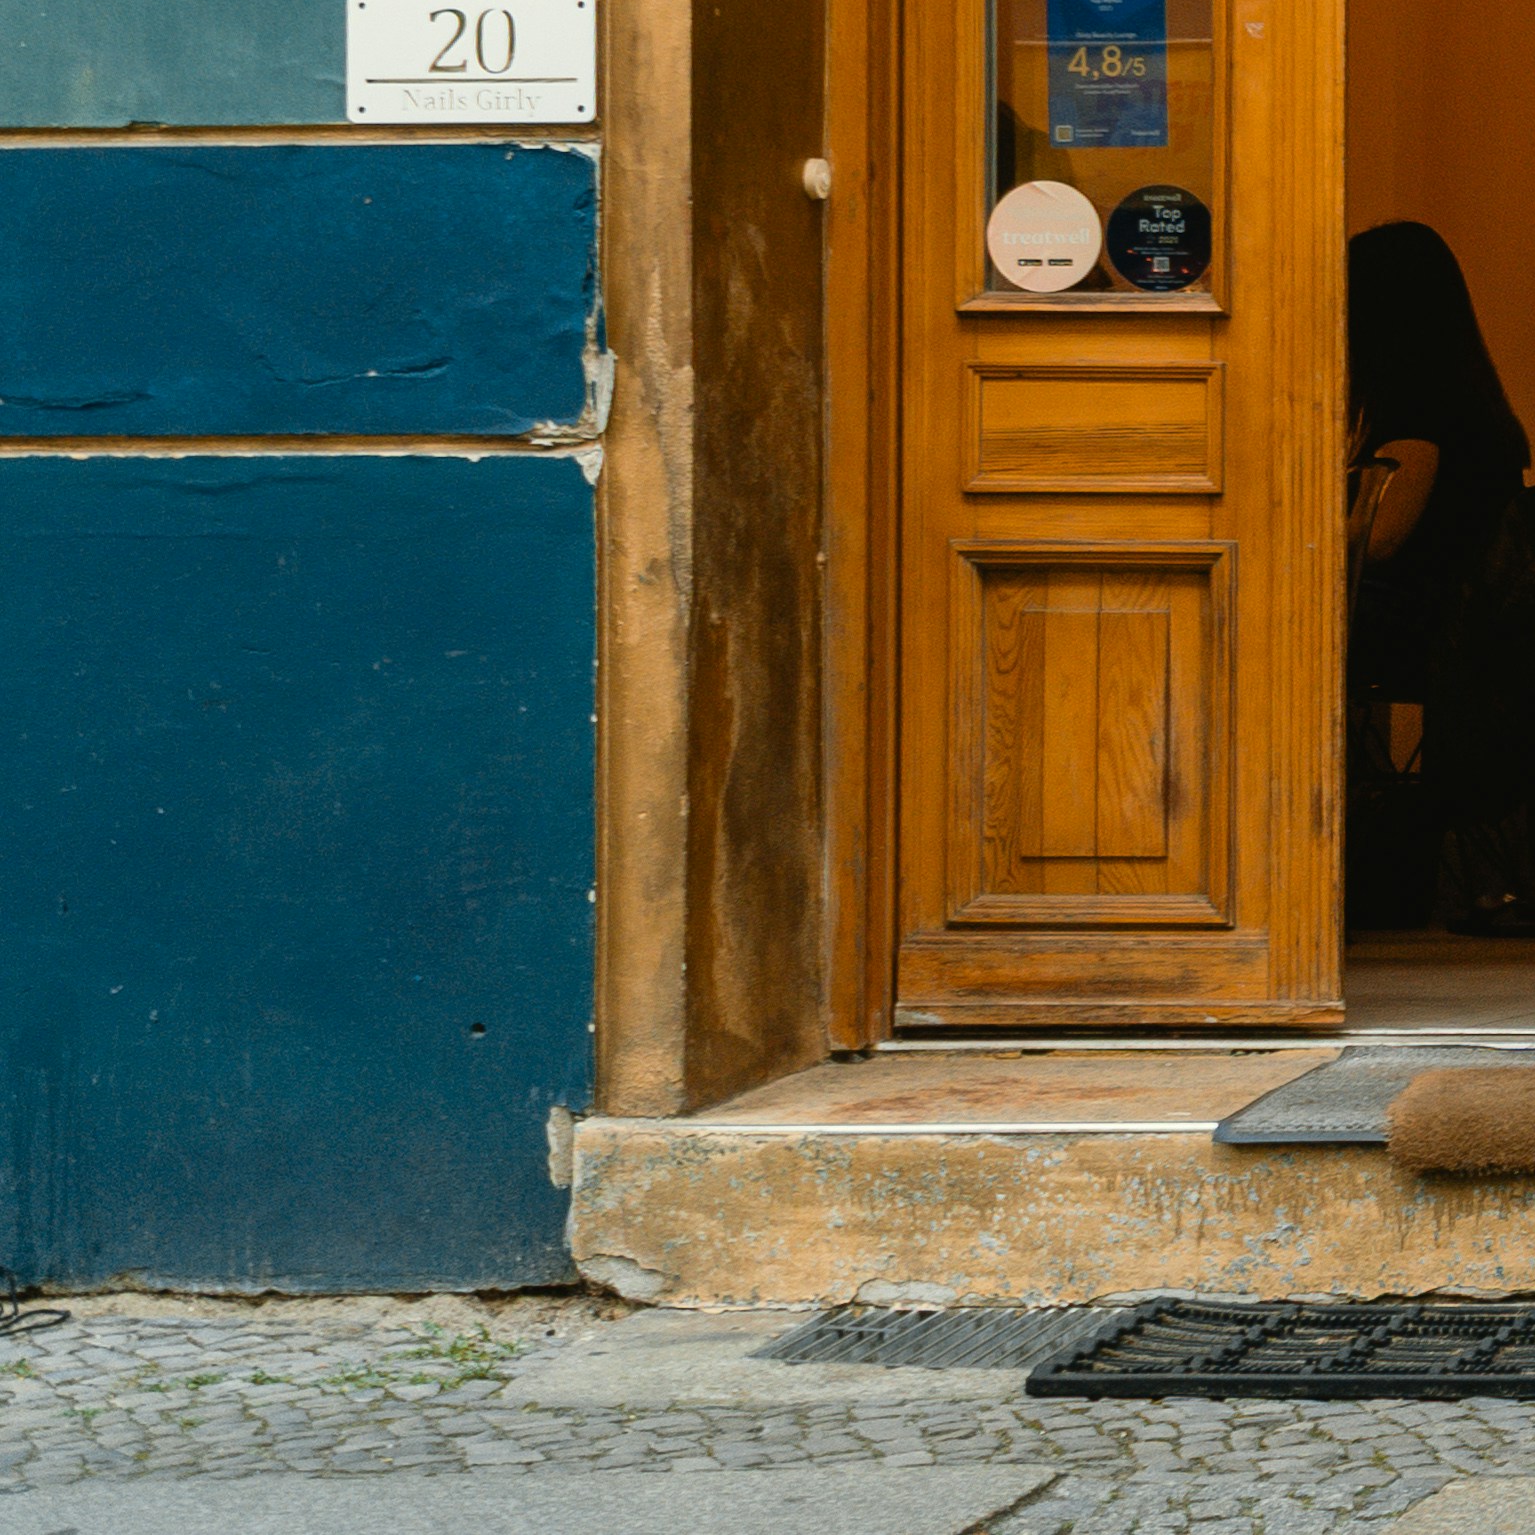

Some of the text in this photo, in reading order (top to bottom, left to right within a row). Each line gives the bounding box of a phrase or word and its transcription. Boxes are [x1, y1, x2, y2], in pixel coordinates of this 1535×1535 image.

[427, 7, 516, 75] 20
[1067, 44, 1147, 81] 4,8/5
[402, 88, 542, 117] Nails Girly
[1151, 205, 1182, 222] Top
[1001, 227, 1090, 245] treatwell
[1138, 219, 1186, 234] Rated
